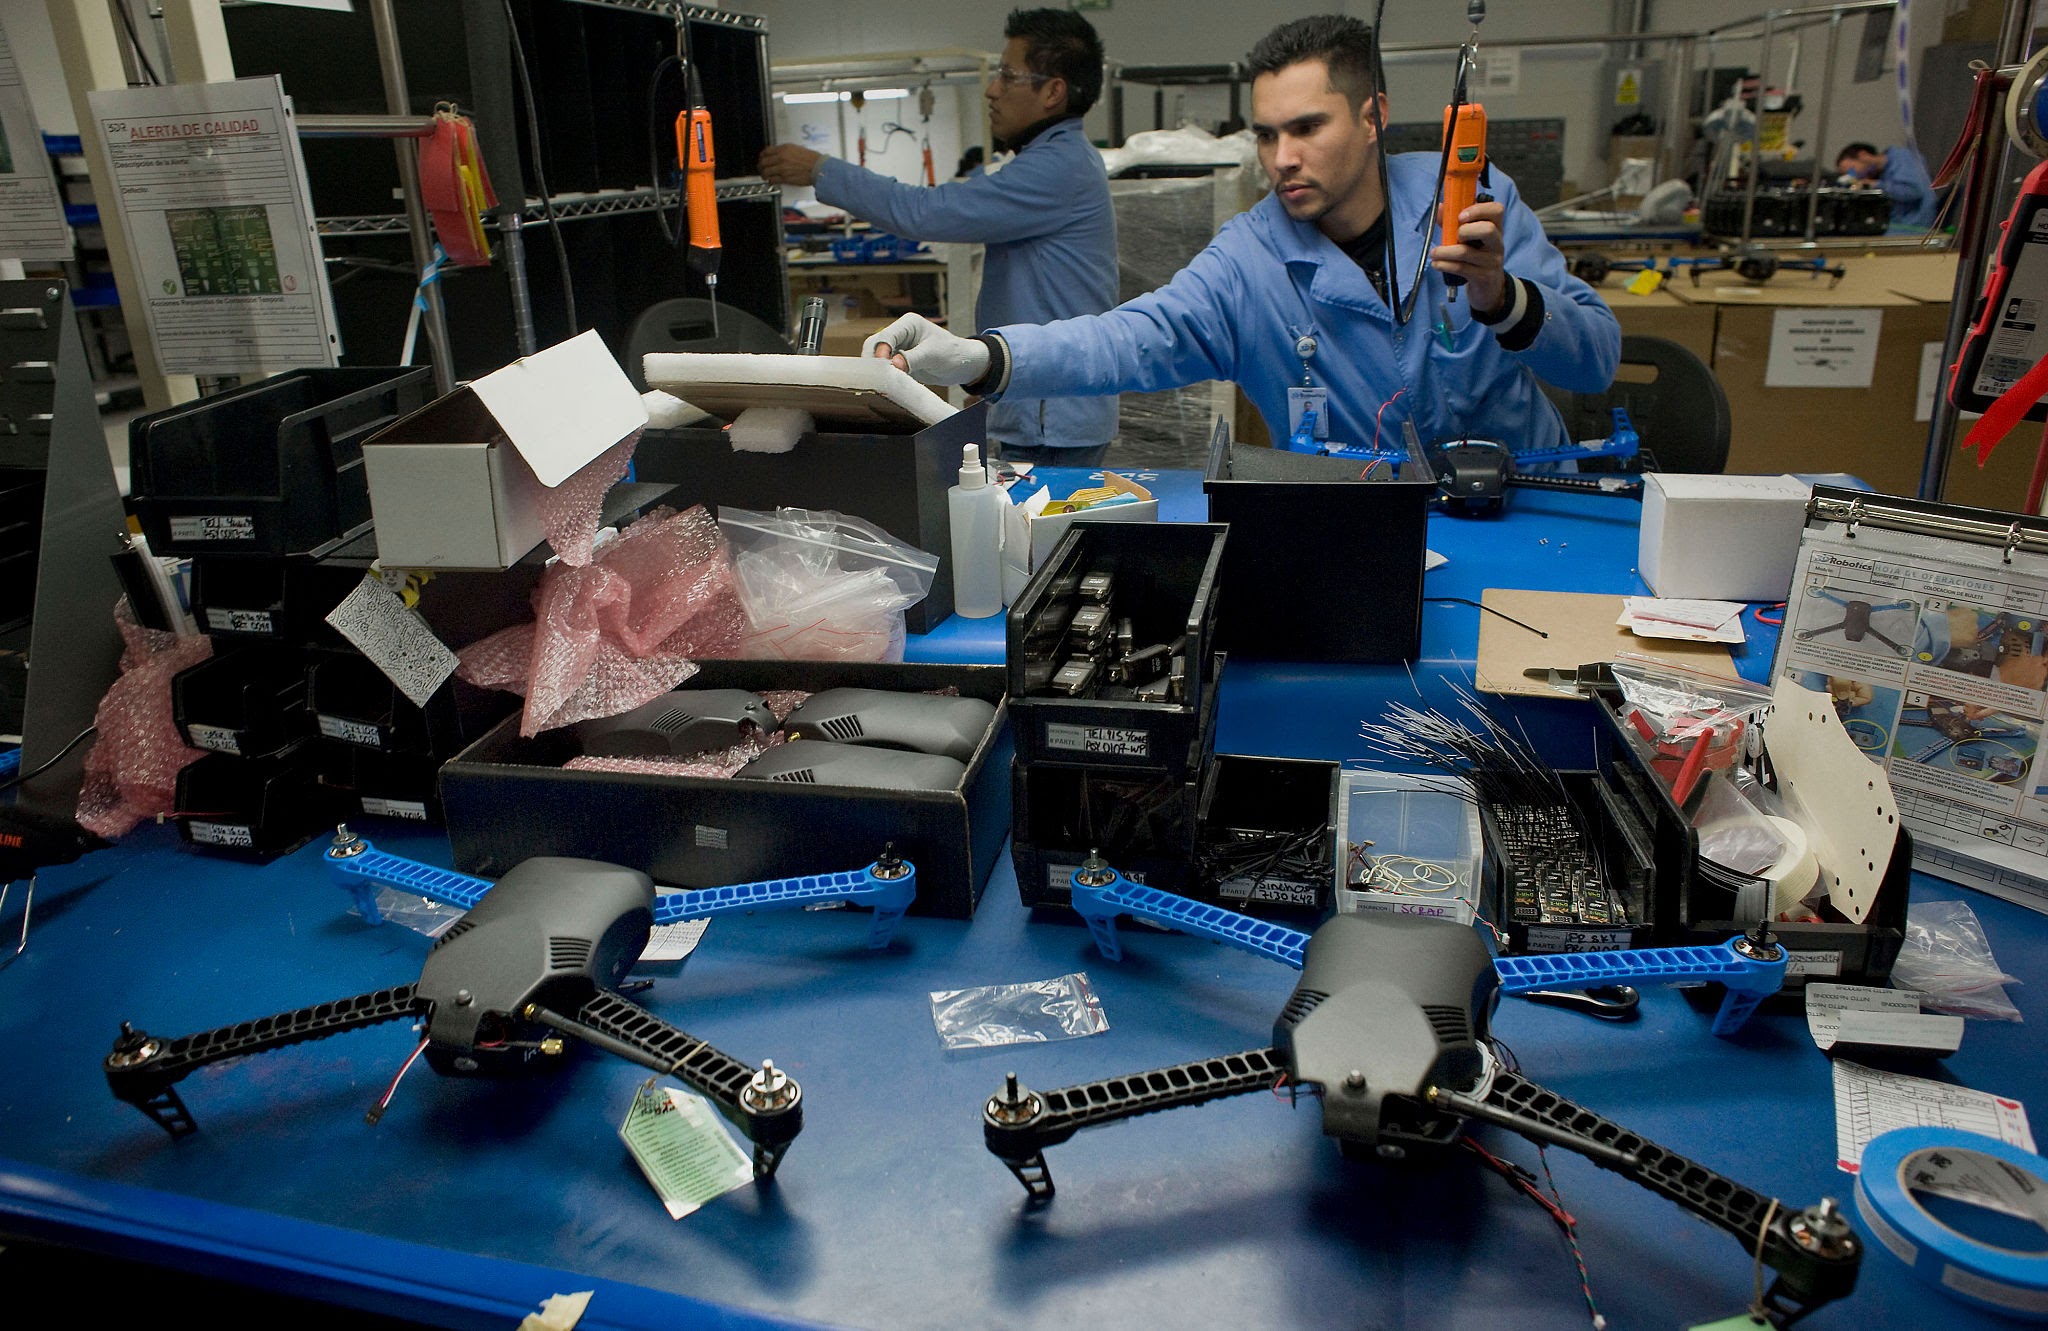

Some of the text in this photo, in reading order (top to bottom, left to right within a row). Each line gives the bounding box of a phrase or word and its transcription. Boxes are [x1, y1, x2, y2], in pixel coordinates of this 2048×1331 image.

[130, 119, 260, 140] ALERTA DE CALIDAD
[1875, 564, 1901, 576] HOJA
[1921, 572, 1995, 592] OPERACIONES
[1934, 601, 1941, 609] 2
[1914, 695, 1921, 703] 5
[1401, 905, 1445, 917] SCRAP
[1828, 1002, 1848, 1010] NITTO
